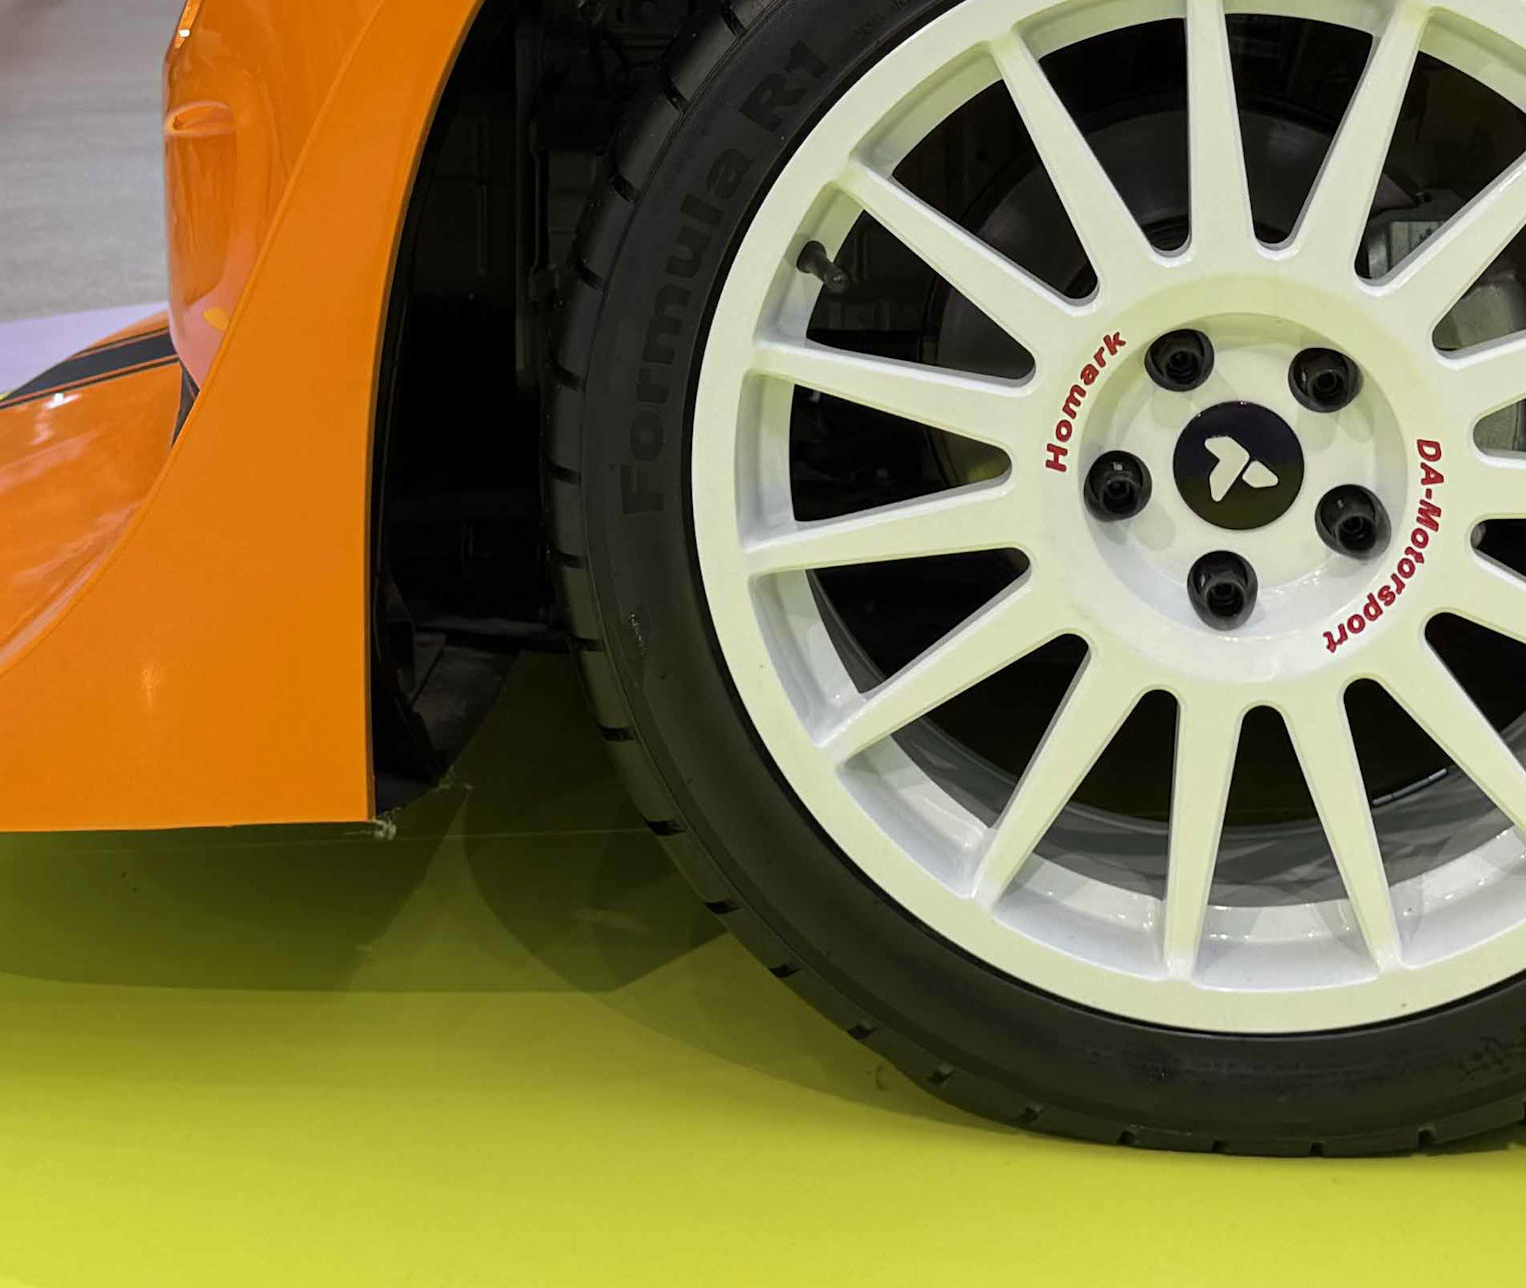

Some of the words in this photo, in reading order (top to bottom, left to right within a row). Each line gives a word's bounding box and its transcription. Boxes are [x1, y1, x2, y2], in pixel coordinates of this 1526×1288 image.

[619, 146, 758, 515] Formula
[738, 38, 829, 140] R1
[1044, 330, 1127, 473] Homark
[1321, 437, 1446, 654] DA-Motorsport
